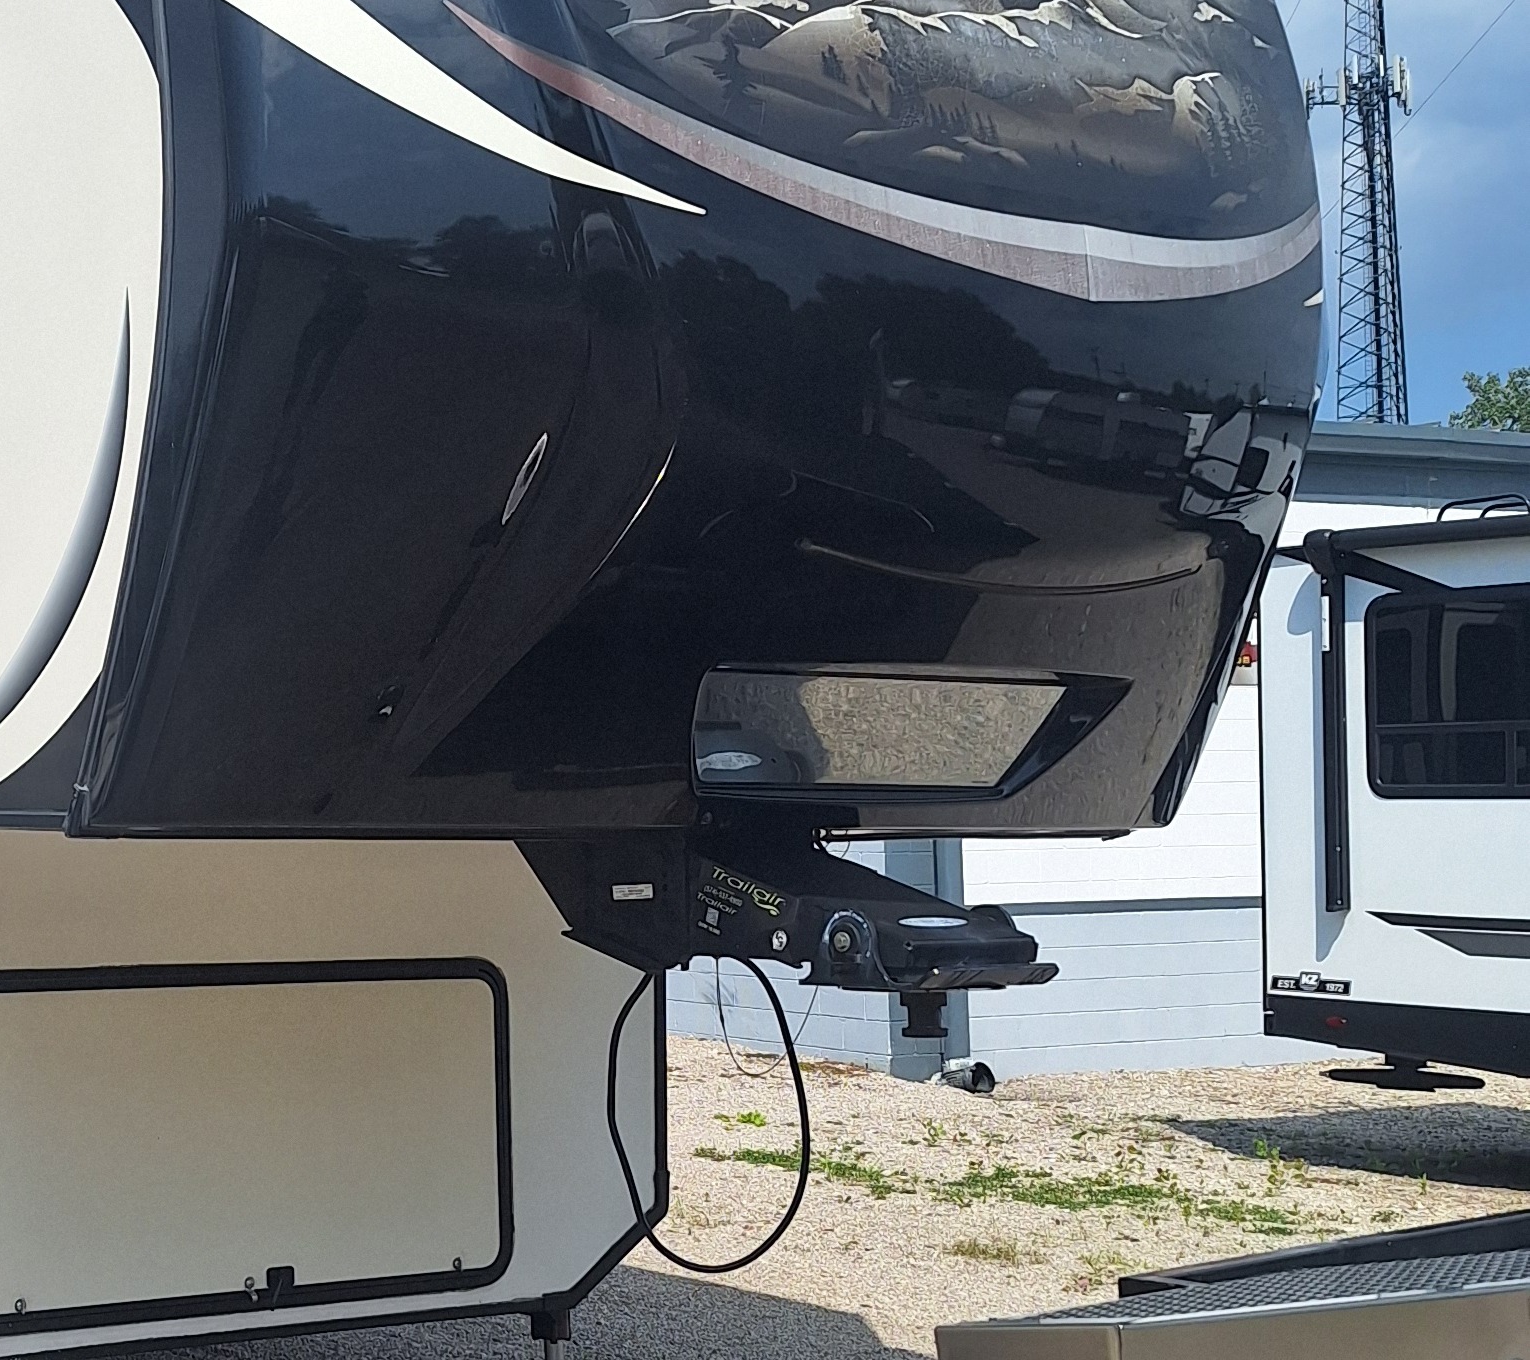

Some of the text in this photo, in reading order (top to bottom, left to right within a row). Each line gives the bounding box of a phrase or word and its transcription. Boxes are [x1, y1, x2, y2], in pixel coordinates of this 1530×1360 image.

[712, 865, 786, 908] Trailair
[1277, 973, 1345, 993] EST. KZ 1972
